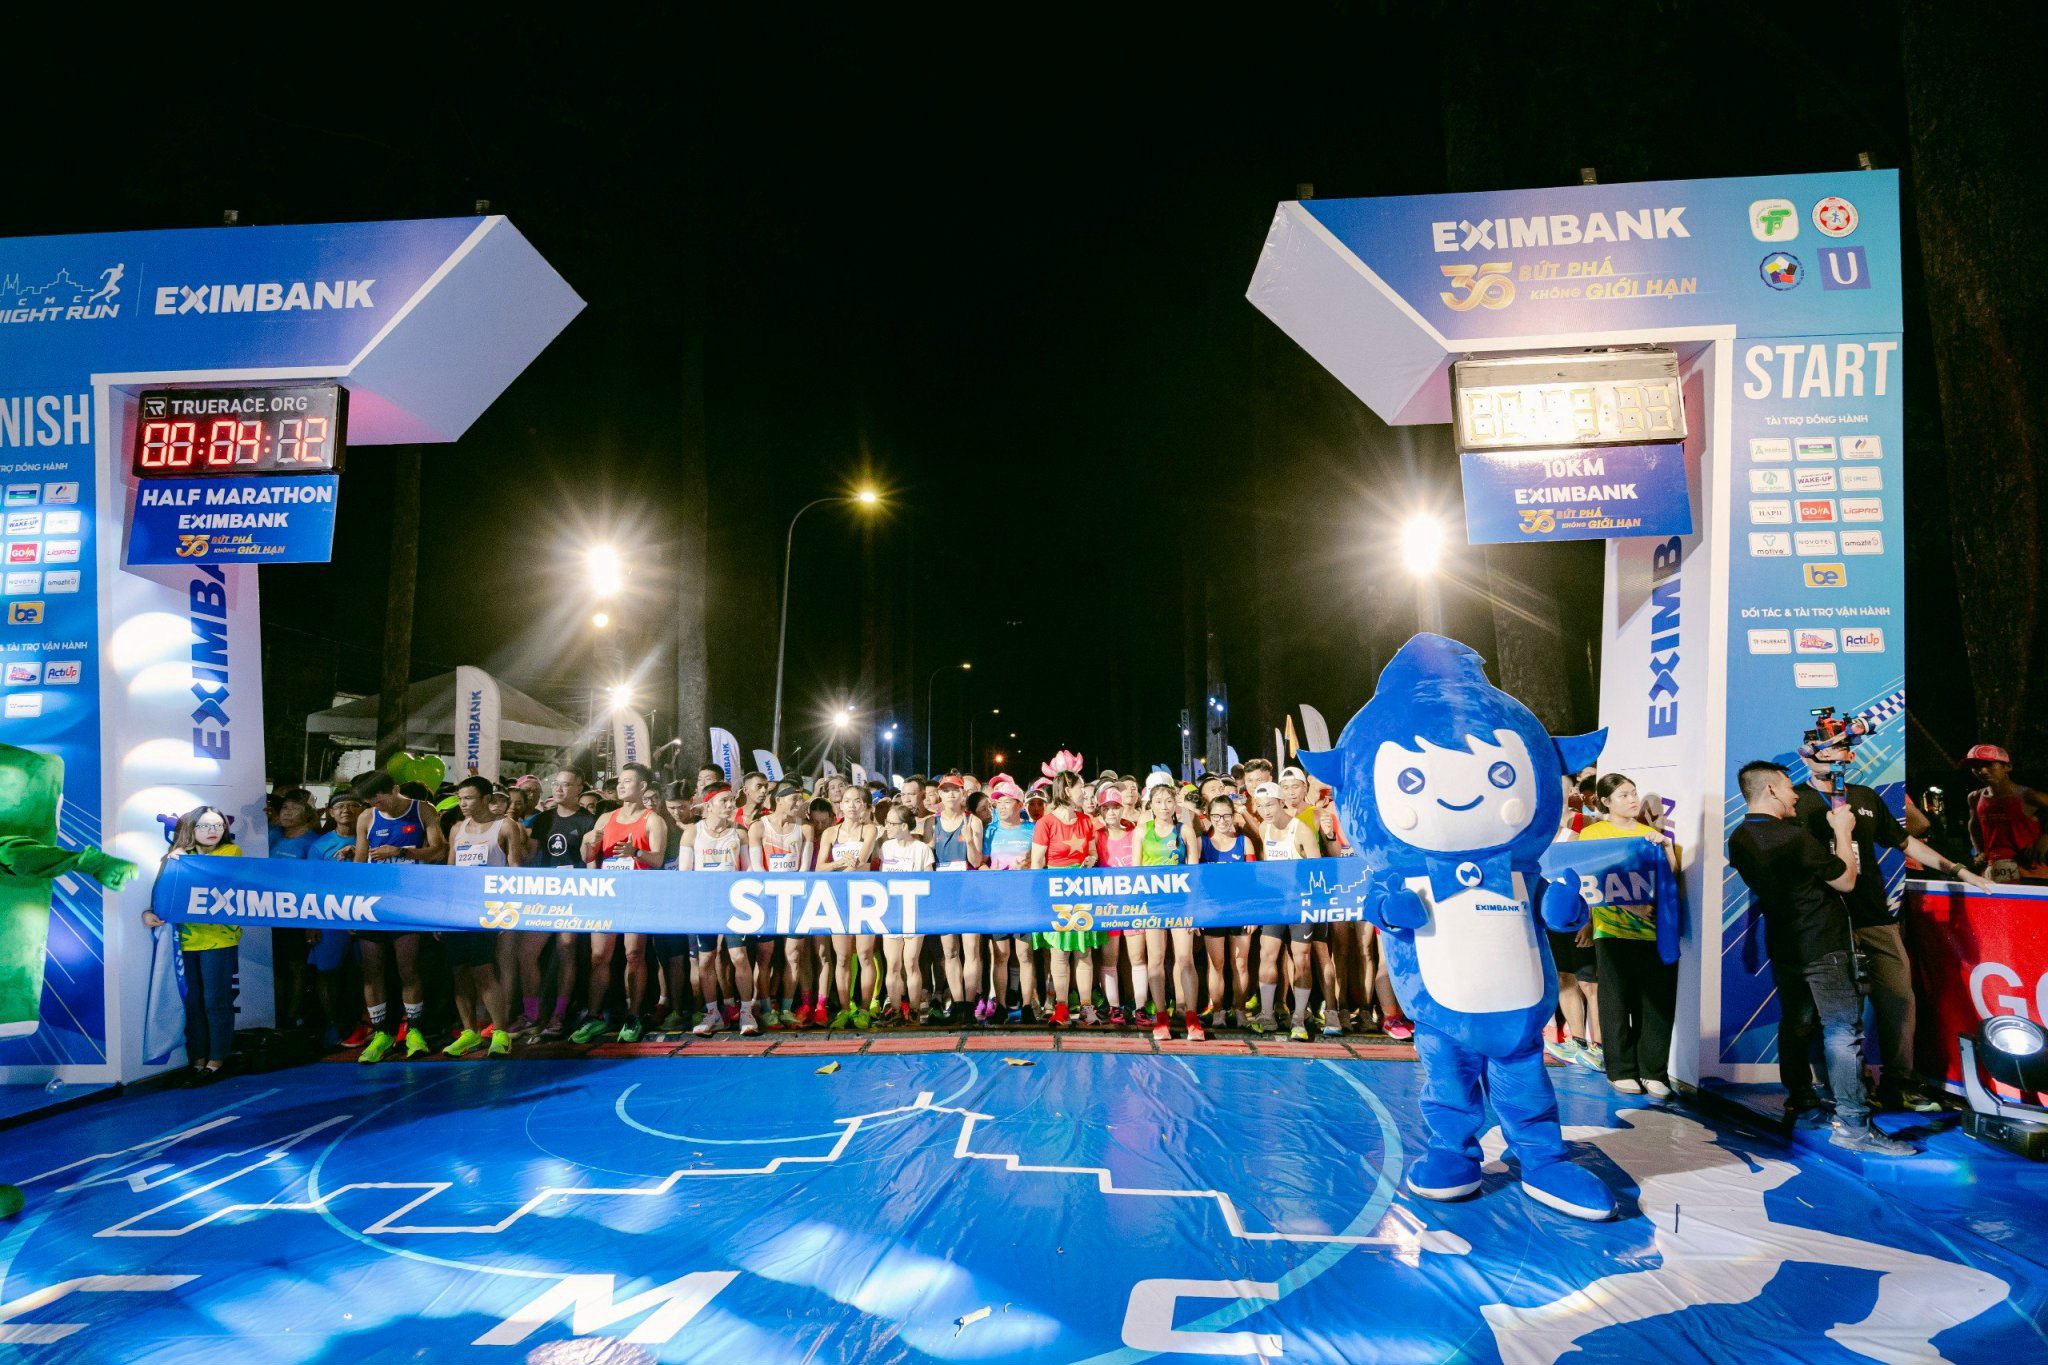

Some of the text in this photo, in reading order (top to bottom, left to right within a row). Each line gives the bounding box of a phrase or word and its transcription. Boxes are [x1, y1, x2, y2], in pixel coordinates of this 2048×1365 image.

[1432, 207, 1690, 252] EXIMBANK
[1519, 260, 1561, 281] BỨT
[1567, 256, 1613, 277] PHÁ
[155, 279, 375, 315] EXIMBANK
[1531, 277, 1697, 300] KHÔNG GIỚI HẠN
[65, 304, 120, 320] RUN
[1744, 342, 1897, 399] START
[171, 397, 308, 415] TRUERACE.ORG
[1765, 413, 1868, 426] TÀI TRỢ ĐỒNG HÀNH
[141, 416, 328, 468] 00:04:12
[42, 461, 68, 470] HÀNH
[1543, 457, 1605, 478] 10KM
[1798, 475, 1832, 484] WAKE-UP
[141, 485, 333, 506] HALF MARATHON
[1515, 483, 1639, 504] EXIMBANK
[178, 512, 289, 529] EXIMBANK
[1556, 508, 1576, 519] BỨT
[1579, 507, 1602, 518] PHÁ
[1588, 518, 1614, 528] GIỚI
[1616, 518, 1641, 529] HẠN
[211, 534, 231, 544] BỨT
[231, 533, 253, 543] PHÁ
[237, 545, 261, 554] GIỚI
[263, 545, 286, 555] HẠN
[1810, 565, 1839, 584] be
[15, 604, 38, 622] be
[1741, 605, 1890, 618] ĐỐI TÁC & TÀI TRỢ VẬN HÀNH
[7, 641, 88, 652] TÀI TRỢ VẬN HÀNH
[467, 690, 482, 769] EXIMBANK
[458, 852, 484, 861] 22276
[484, 875, 616, 897] EXIMBANK
[1049, 872, 1191, 897] EXIMBANK
[187, 886, 383, 923] EXIMBANK
[548, 903, 574, 916] PHÁ
[726, 879, 931, 934] START
[1095, 902, 1119, 916] BỨT
[1121, 902, 1149, 916] PHÁ
[1475, 904, 1520, 912] EXIMBANK
[553, 917, 581, 930] GIỚI
[1131, 916, 1162, 929] GIỚI
